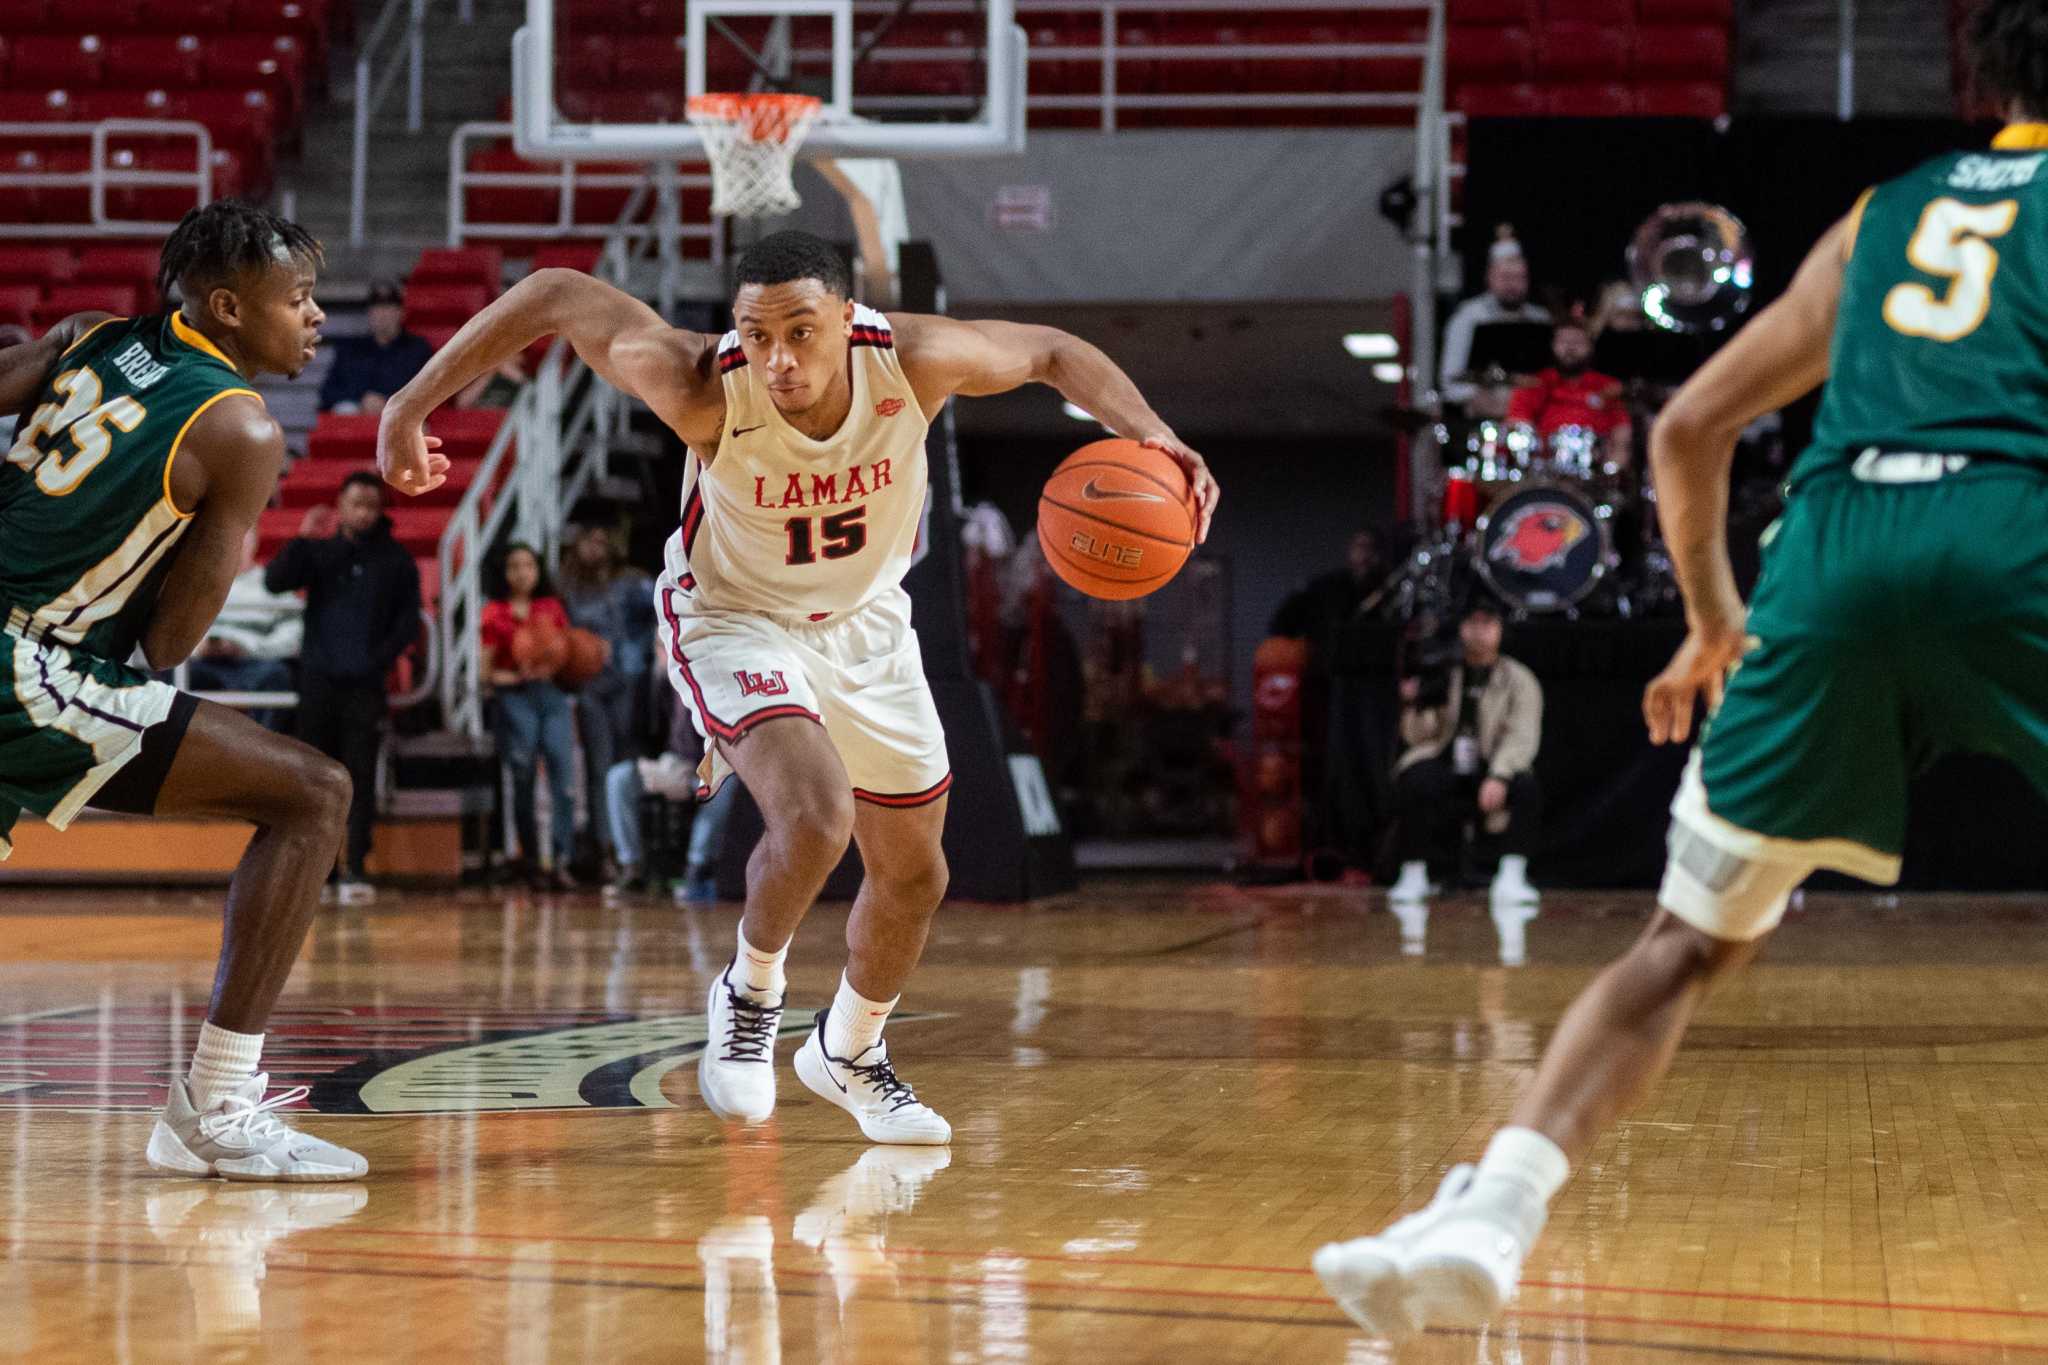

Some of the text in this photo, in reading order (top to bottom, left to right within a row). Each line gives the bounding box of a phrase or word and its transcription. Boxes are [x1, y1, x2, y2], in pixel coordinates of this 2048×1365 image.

[1882, 196, 2019, 342] 5
[6, 364, 147, 496] 25
[754, 457, 892, 509] LAMAR
[784, 504, 867, 566] 15
[1071, 530, 1144, 568] ELITE
